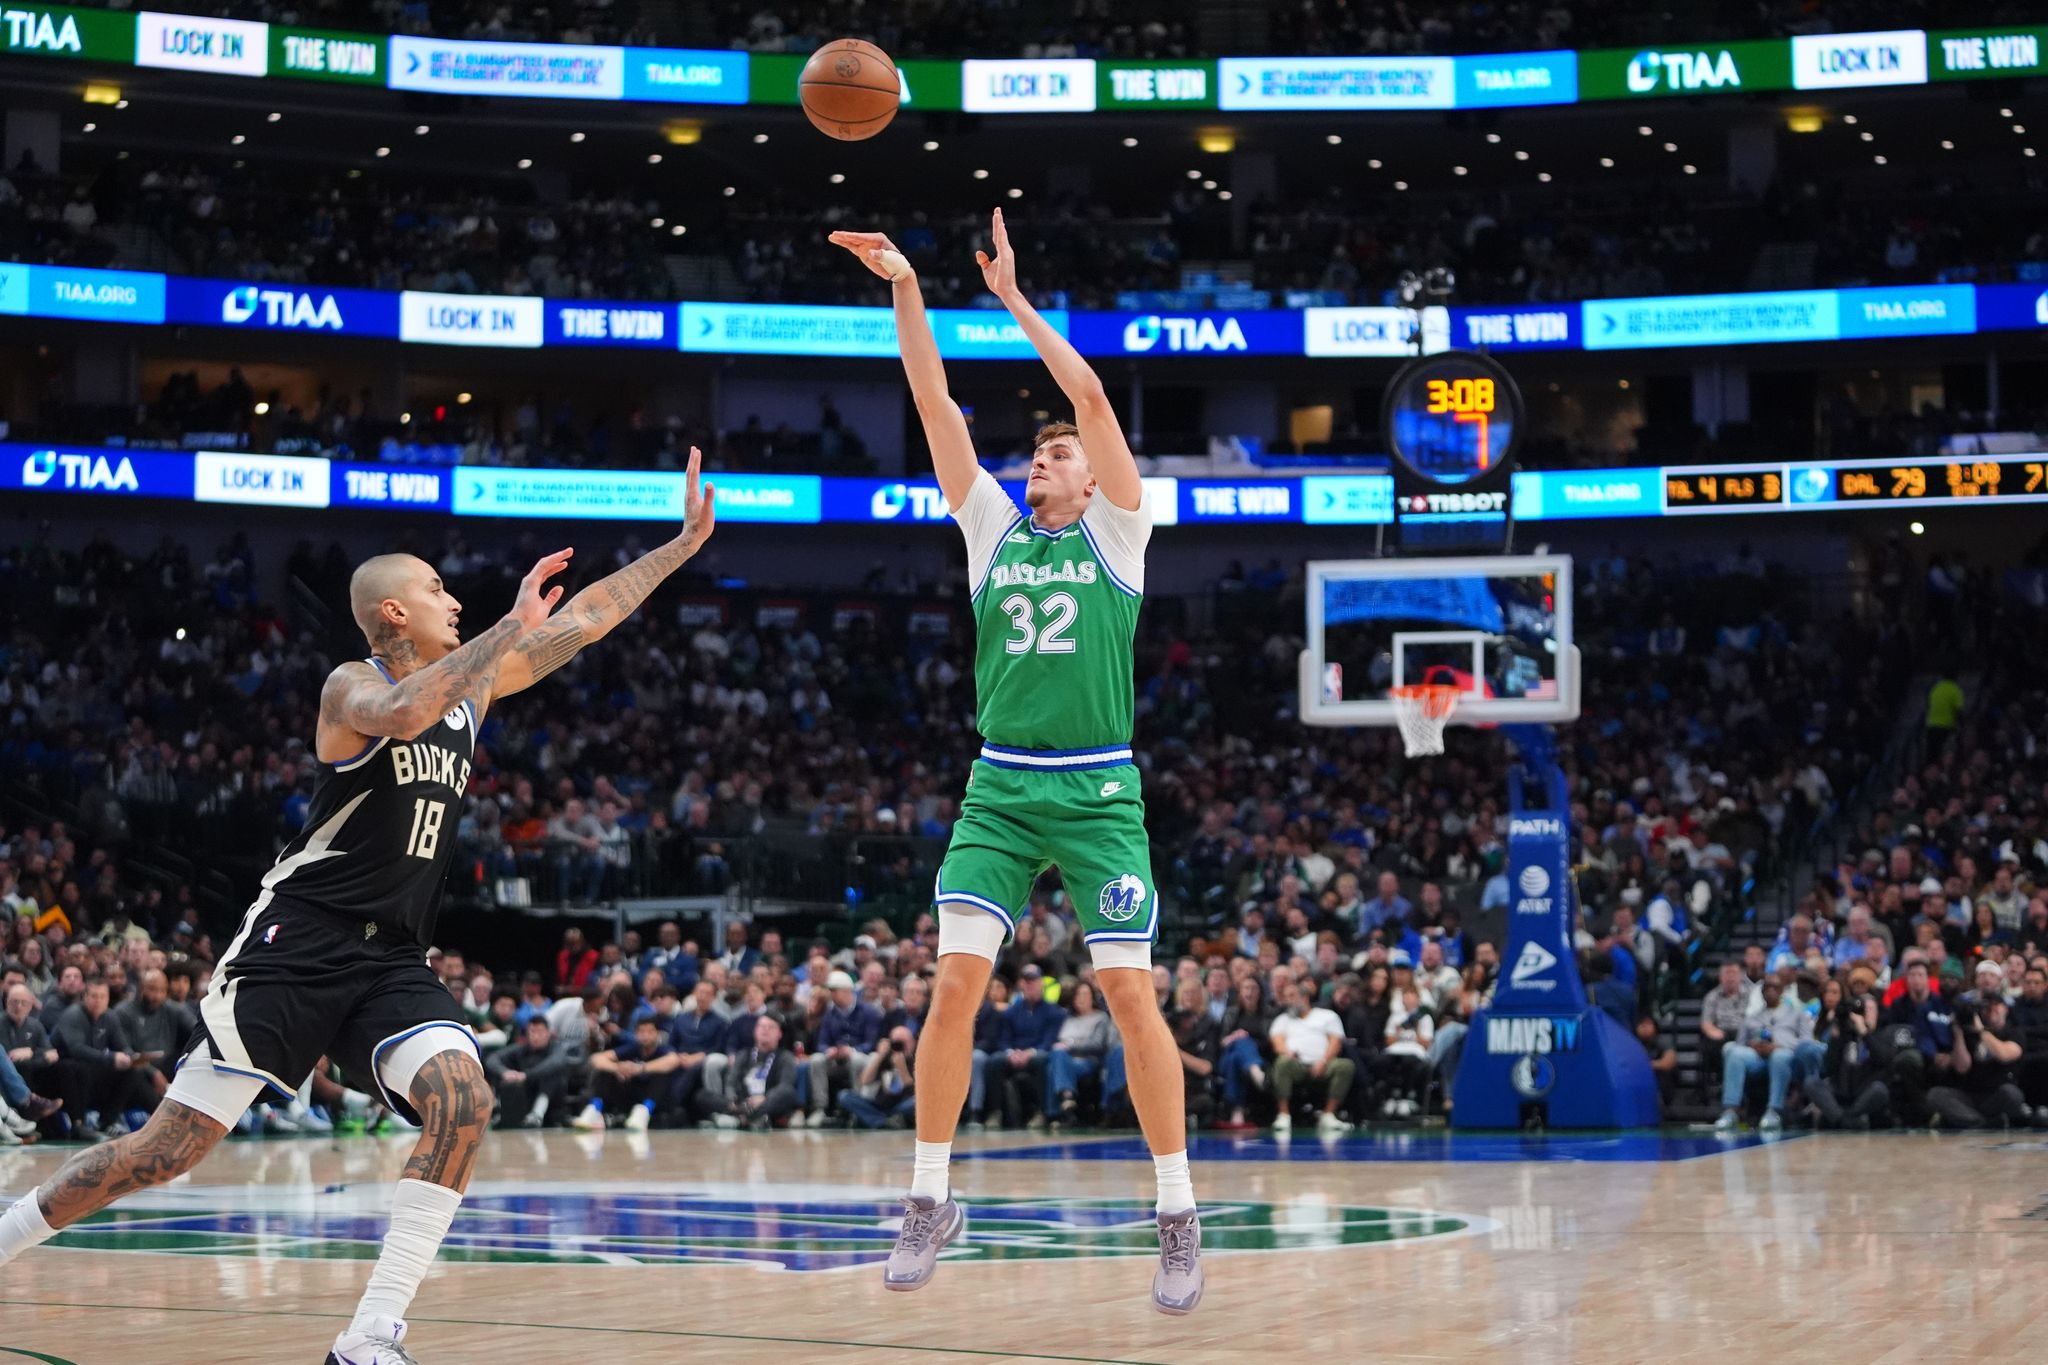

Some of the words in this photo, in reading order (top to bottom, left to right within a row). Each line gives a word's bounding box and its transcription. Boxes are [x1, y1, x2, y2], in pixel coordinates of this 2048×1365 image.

[3, 10, 82, 52] TIAA
[161, 27, 213, 56] LOCK
[220, 32, 244, 58] IN
[283, 36, 326, 71] THE
[326, 40, 376, 75] WIN
[1819, 48, 1871, 73] LOCK
[1877, 47, 1900, 72] IN
[1941, 37, 1986, 70] THE
[1986, 35, 2038, 68] WIN
[990, 73, 1040, 98] LOCK
[1048, 73, 1070, 98] IN
[1109, 69, 1155, 101] THE
[1155, 69, 1206, 101] WIN
[1661, 50, 1741, 89] TIAA
[55, 281, 138, 305] TIAA.ORG
[260, 290, 344, 330] TIAA
[427, 306, 482, 331] LOCK
[491, 308, 516, 332] IN
[559, 308, 607, 338] THE
[608, 309, 664, 340] WIN
[1863, 300, 1946, 321] TIAA.ORG
[1161, 317, 1248, 352] TIAA
[1333, 319, 1390, 342] LOCK
[1464, 314, 1513, 344] THE
[1513, 312, 1568, 342] WIN
[1427, 378, 1495, 414] 3:08
[57, 454, 139, 492] TIAA
[221, 466, 274, 490] LOCK
[281, 469, 304, 492] IN
[344, 470, 389, 501] THE
[389, 472, 440, 504] WIN
[1699, 476, 1717, 502] 4
[1843, 473, 1880, 496] DAL
[1891, 467, 1926, 498] 79
[906, 487, 949, 520] TI
[1191, 486, 1238, 515] THE
[1238, 486, 1290, 515] WIN
[1427, 492, 1507, 513] TISSOT
[991, 560, 1097, 589] DALLAS
[1000, 591, 1078, 654] 32
[391, 743, 472, 799] BUCKS
[406, 798, 446, 860] 18
